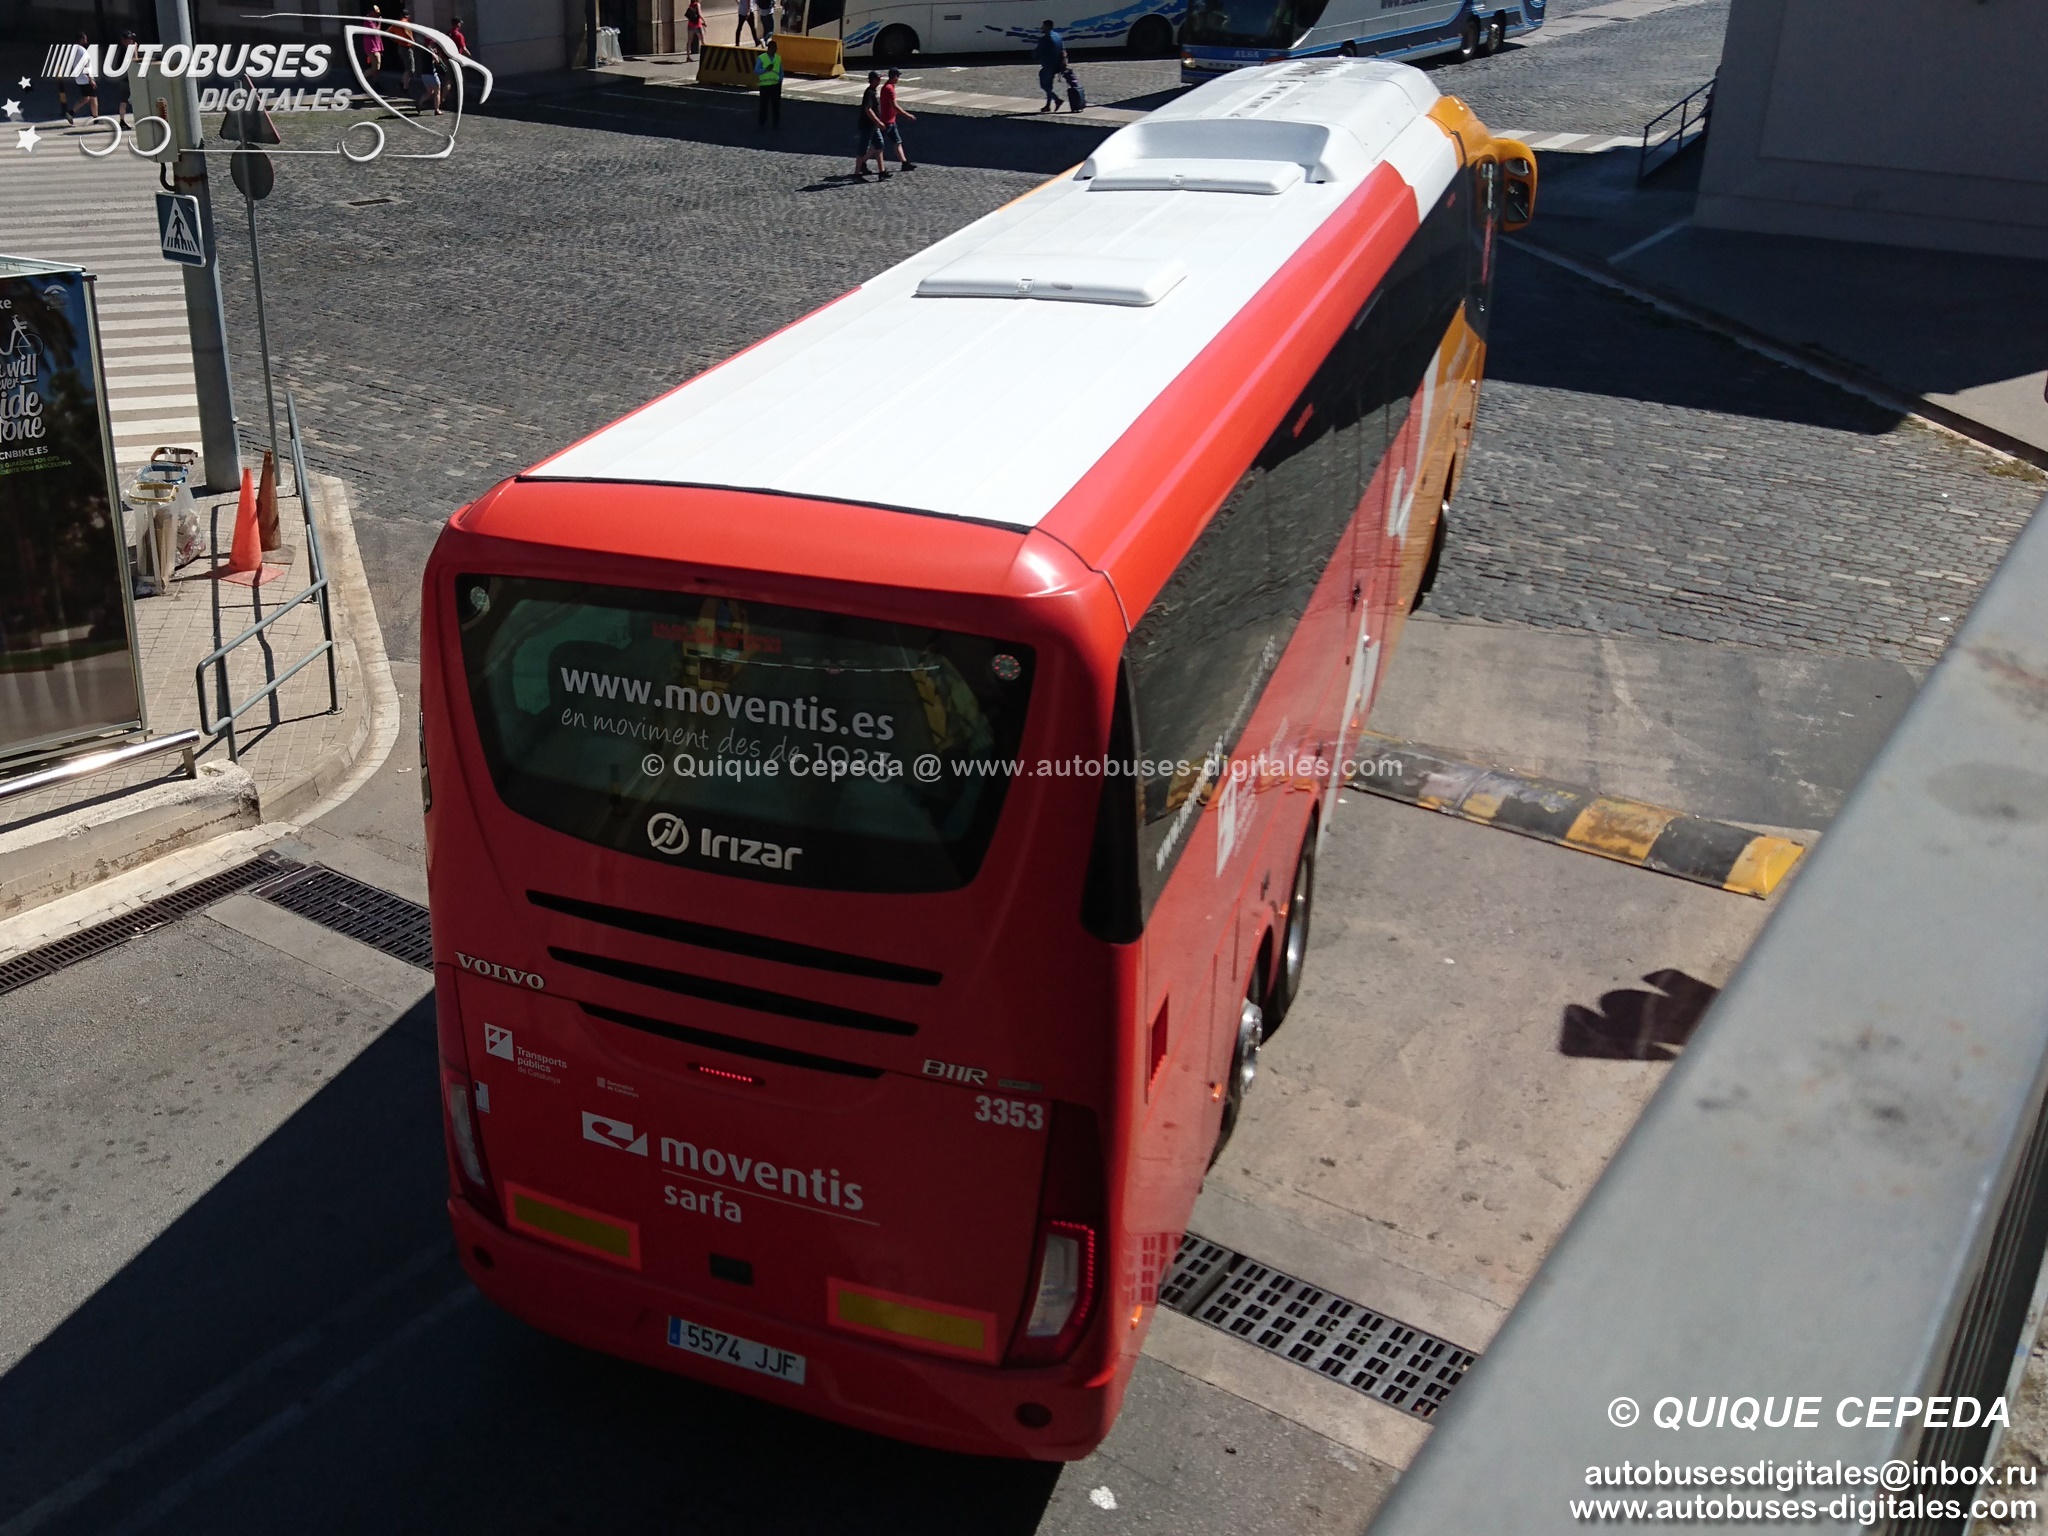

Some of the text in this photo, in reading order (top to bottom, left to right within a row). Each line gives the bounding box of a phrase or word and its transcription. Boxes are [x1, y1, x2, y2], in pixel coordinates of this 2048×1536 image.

[1234, 50, 1259, 58] ALSA
[7, 353, 37, 378] will
[560, 666, 895, 741] www.moventis.es
[560, 706, 588, 730] en
[593, 714, 710, 751] moviment
[717, 728, 761, 759] des
[769, 735, 800, 764] de
[700, 827, 803, 871] Irizar
[454, 951, 546, 991] VOLVO
[516, 1045, 568, 1070] Transports
[517, 1056, 551, 1073] públics
[975, 1095, 1044, 1131] 3353
[660, 1136, 865, 1212] moventis
[664, 1184, 742, 1224] sarfa
[687, 1323, 797, 1377] 5574 JJF
